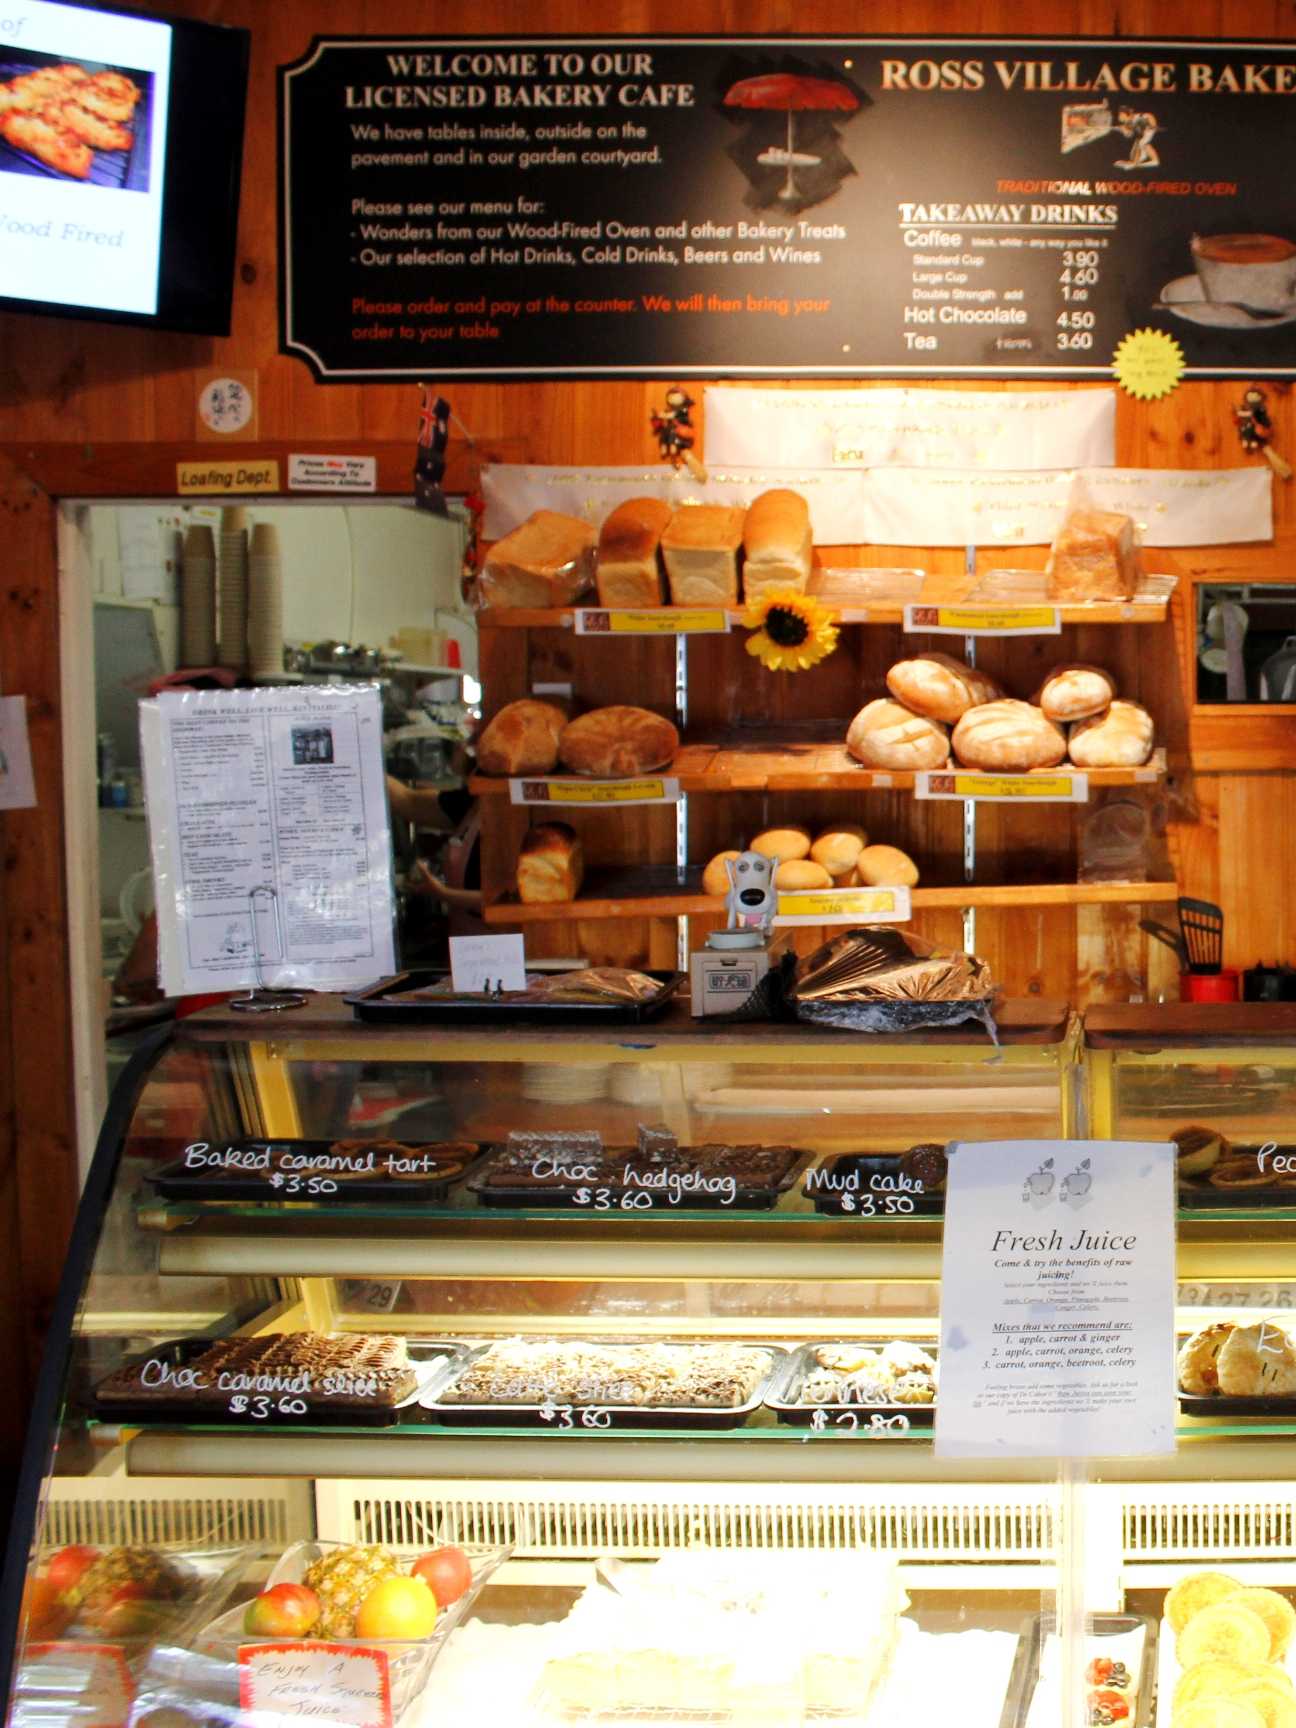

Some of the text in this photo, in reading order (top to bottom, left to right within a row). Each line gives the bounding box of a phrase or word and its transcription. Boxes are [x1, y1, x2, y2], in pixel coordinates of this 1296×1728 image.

[387, 53, 653, 76] WELCOME TO OUR
[882, 61, 984, 90] ROSS
[994, 61, 1176, 92] VILLAGE
[346, 84, 694, 108] LICENSED BAKERY CAFE
[997, 180, 1237, 196] TRADITIONAL WOOD-FIRED OVEN
[899, 203, 1117, 224] TAKEAWAY DRINKS
[0, 214, 125, 248] ood Fired
[360, 220, 846, 242] Wonders from our Wood-Fired Oven and other Bakery Treats
[904, 229, 961, 247] Coffee
[360, 245, 821, 266] Our selection of Hot Drinks, Cold Drinks, Beers and Wines
[913, 251, 1098, 267] Standard Cup 3.90
[912, 268, 1098, 285] Large Cup 4.60
[904, 307, 1095, 328] Hot Chocolate 4.50
[903, 332, 1093, 349] Tea 3.60
[180, 470, 272, 487] Loafing Dept.
[184, 1143, 436, 1173] Baked caramel tart
[269, 1172, 337, 1193] $3.50
[532, 1159, 735, 1204] Choc hedgehog
[806, 1168, 924, 1194] Mud cake
[573, 1188, 652, 1210] $3.60
[841, 1194, 914, 1216] $3.50
[992, 1230, 1137, 1251] Fresh Juice
[994, 1258, 1132, 1270] Come & try the benefits of raw
[1037, 1269, 1075, 1281] juicing!
[1006, 1334, 1120, 1345] 1. apple, carrot & ginger
[992, 1345, 1133, 1358] 2. apple, carrot, orange, celery
[983, 1358, 1135, 1370] 3. carrot, orange, beetroot, celery
[140, 1359, 376, 1396] Choc caramel slice
[229, 1395, 307, 1418] $3.60
